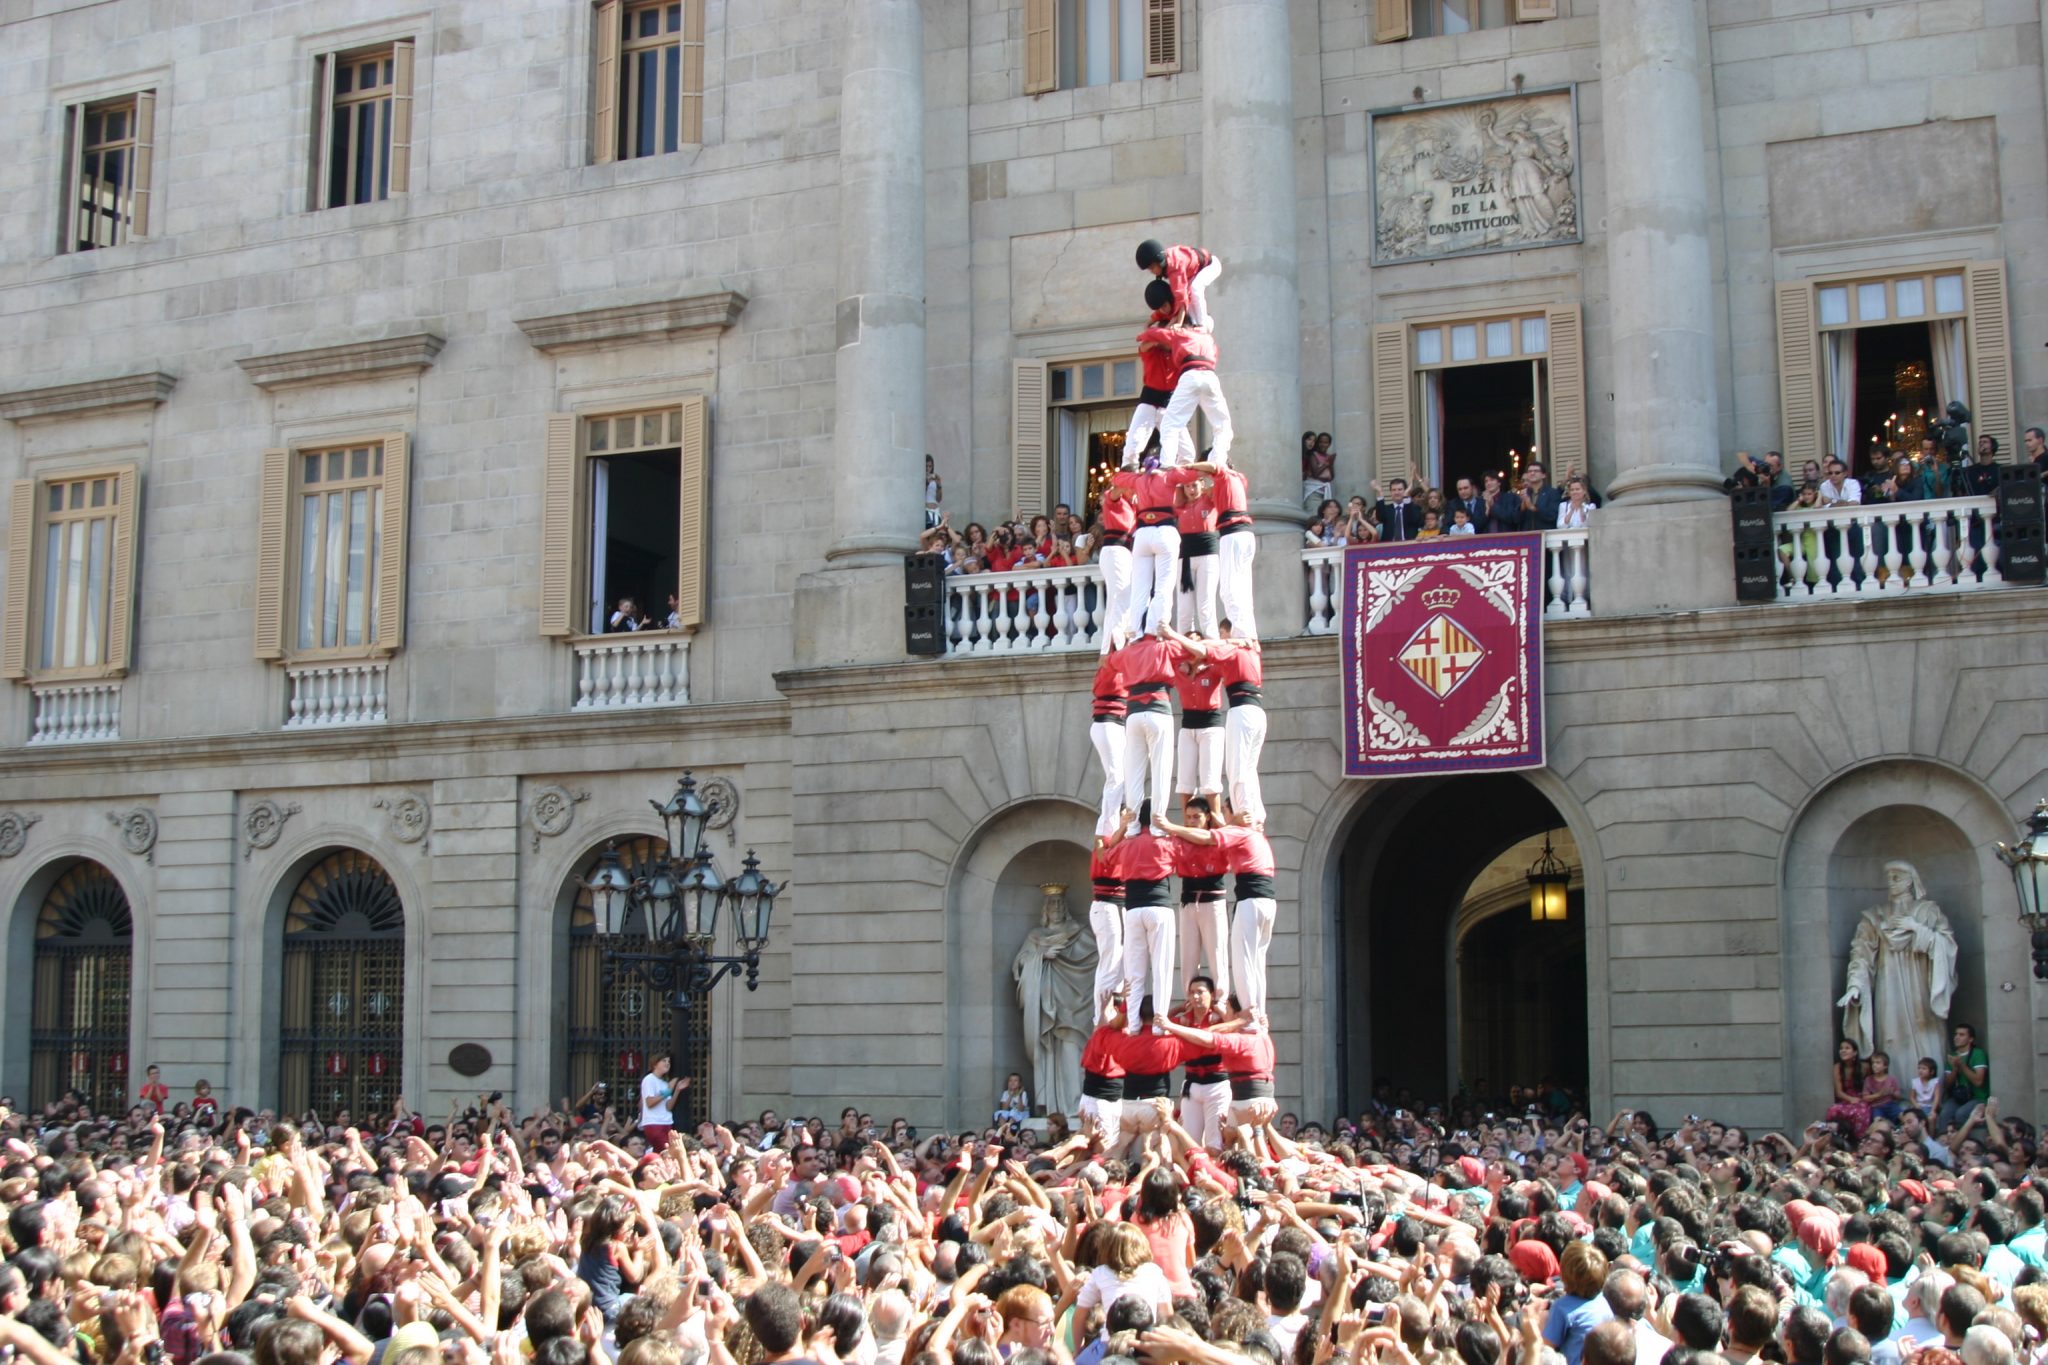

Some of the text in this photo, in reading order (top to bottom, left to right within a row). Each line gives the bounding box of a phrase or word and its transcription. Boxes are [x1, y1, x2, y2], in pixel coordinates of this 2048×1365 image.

[1452, 182, 1496, 198] PLAZA
[1452, 200, 1498, 215] DE LA
[1429, 213, 1521, 236] CONSTITUCION
